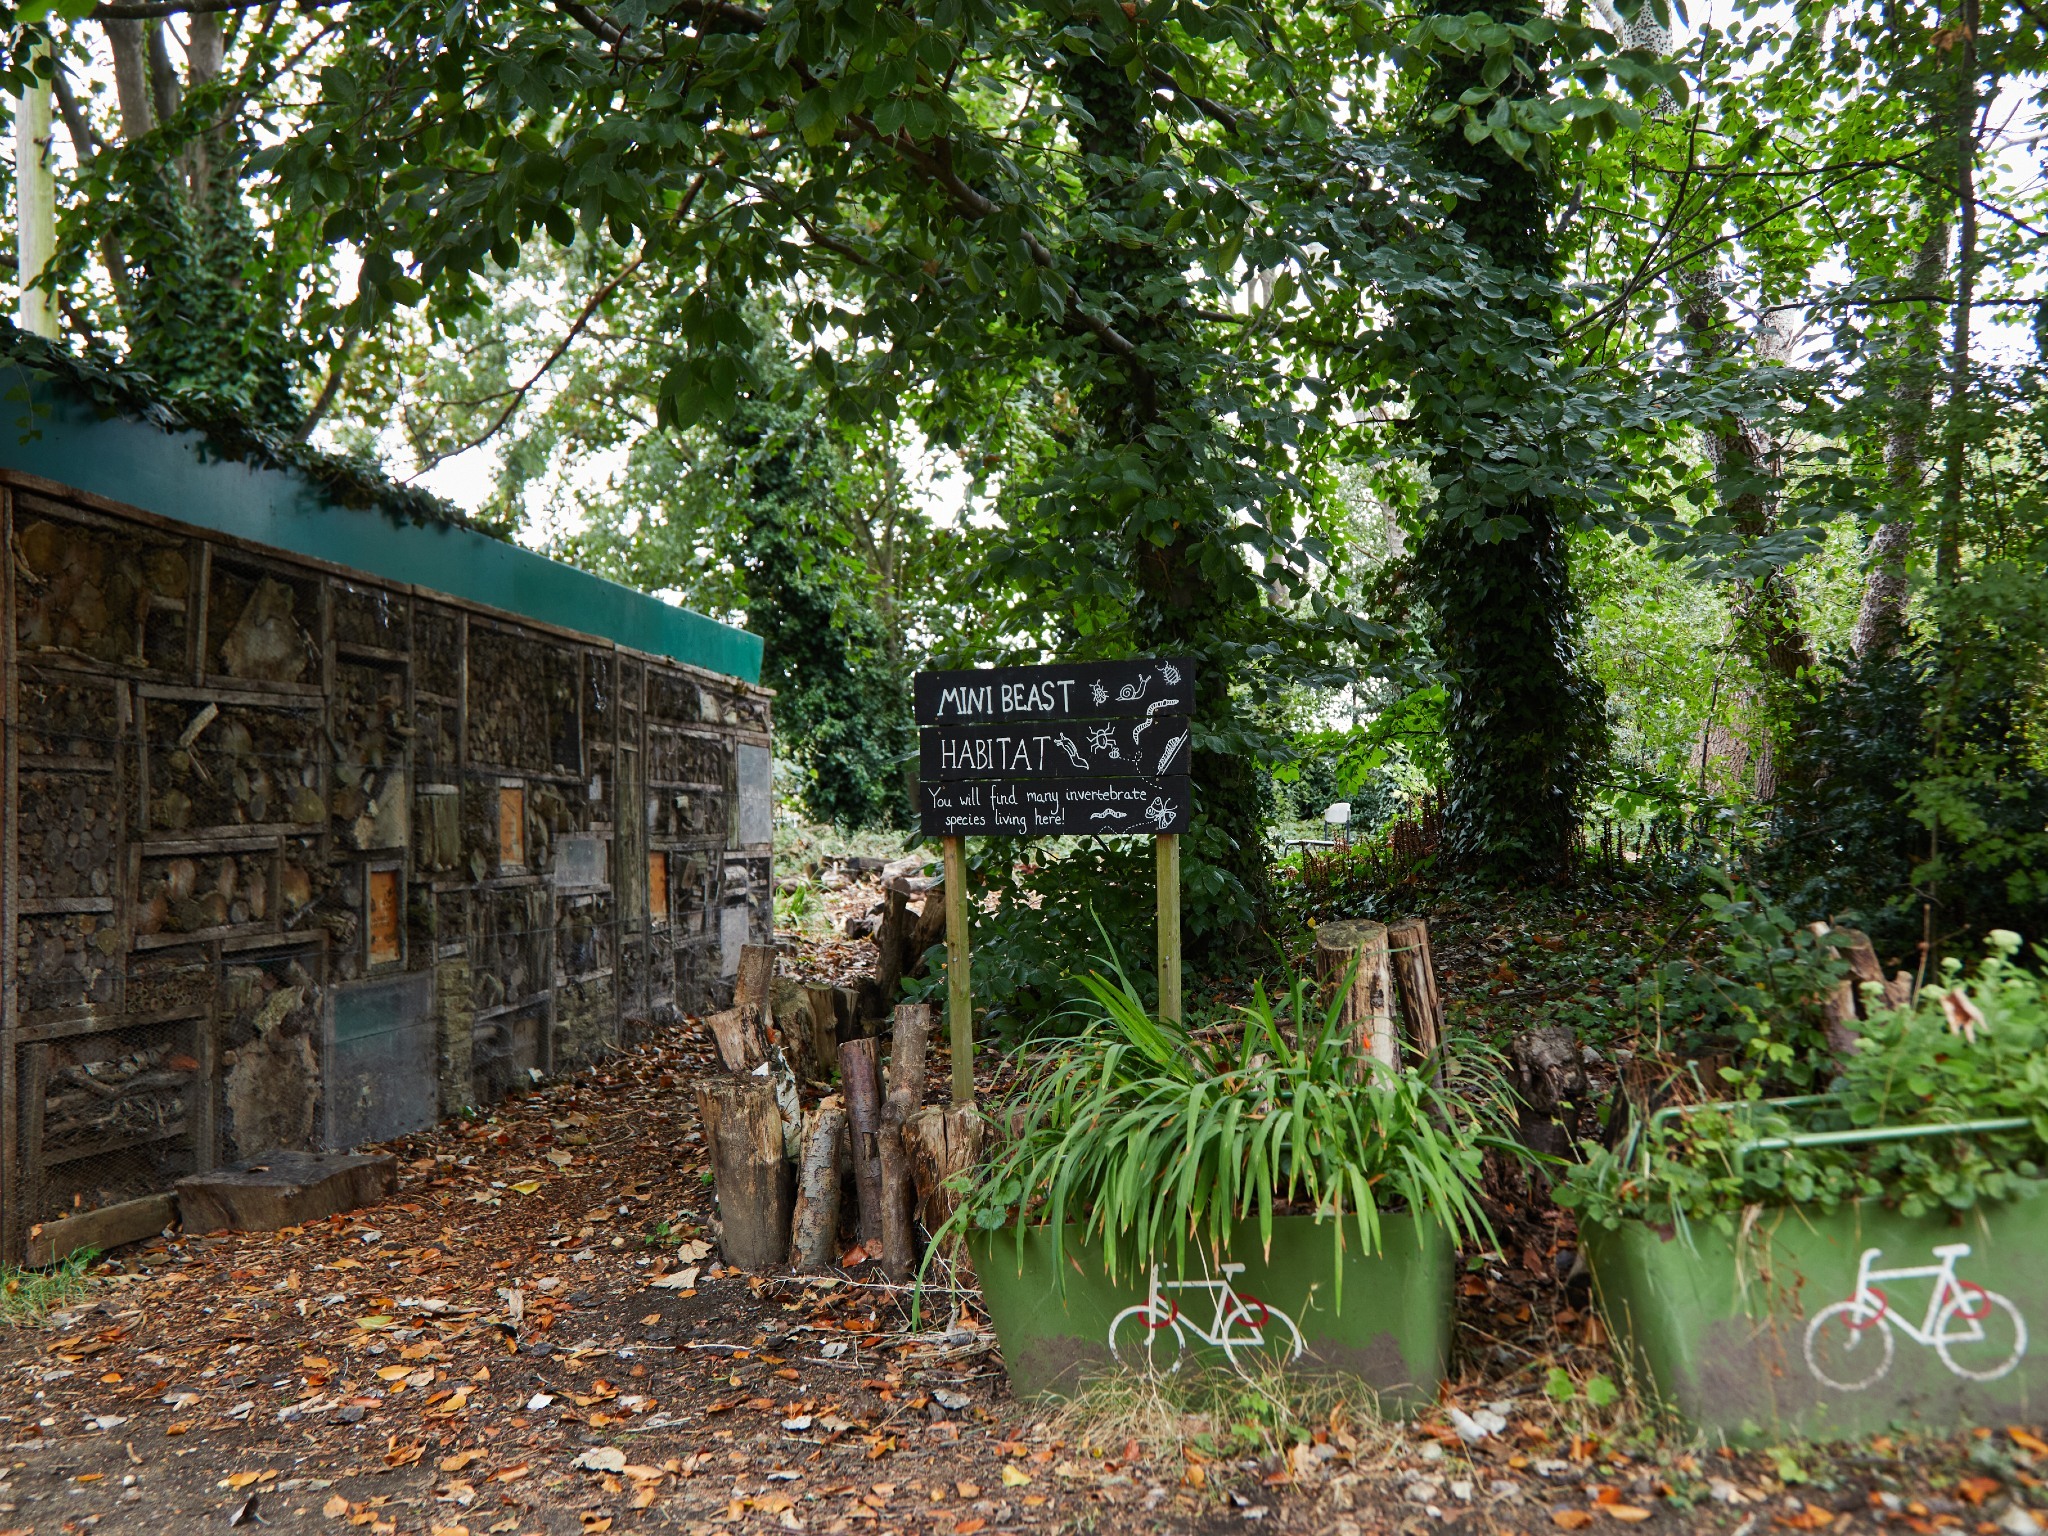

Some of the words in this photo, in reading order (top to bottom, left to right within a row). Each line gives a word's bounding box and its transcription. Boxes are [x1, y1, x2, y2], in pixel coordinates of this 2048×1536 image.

[937, 686, 993, 717] MINI
[1001, 680, 1075, 713] BEAST
[941, 736, 1051, 770] HABITAT
[928, 786, 952, 809] You
[959, 787, 981, 806] will
[990, 784, 1018, 811] find
[1026, 791, 1059, 815] many
[1065, 785, 1147, 801] invertebrate
[945, 812, 986, 834] species
[995, 809, 1027, 835] living
[1034, 807, 1065, 826] here!
